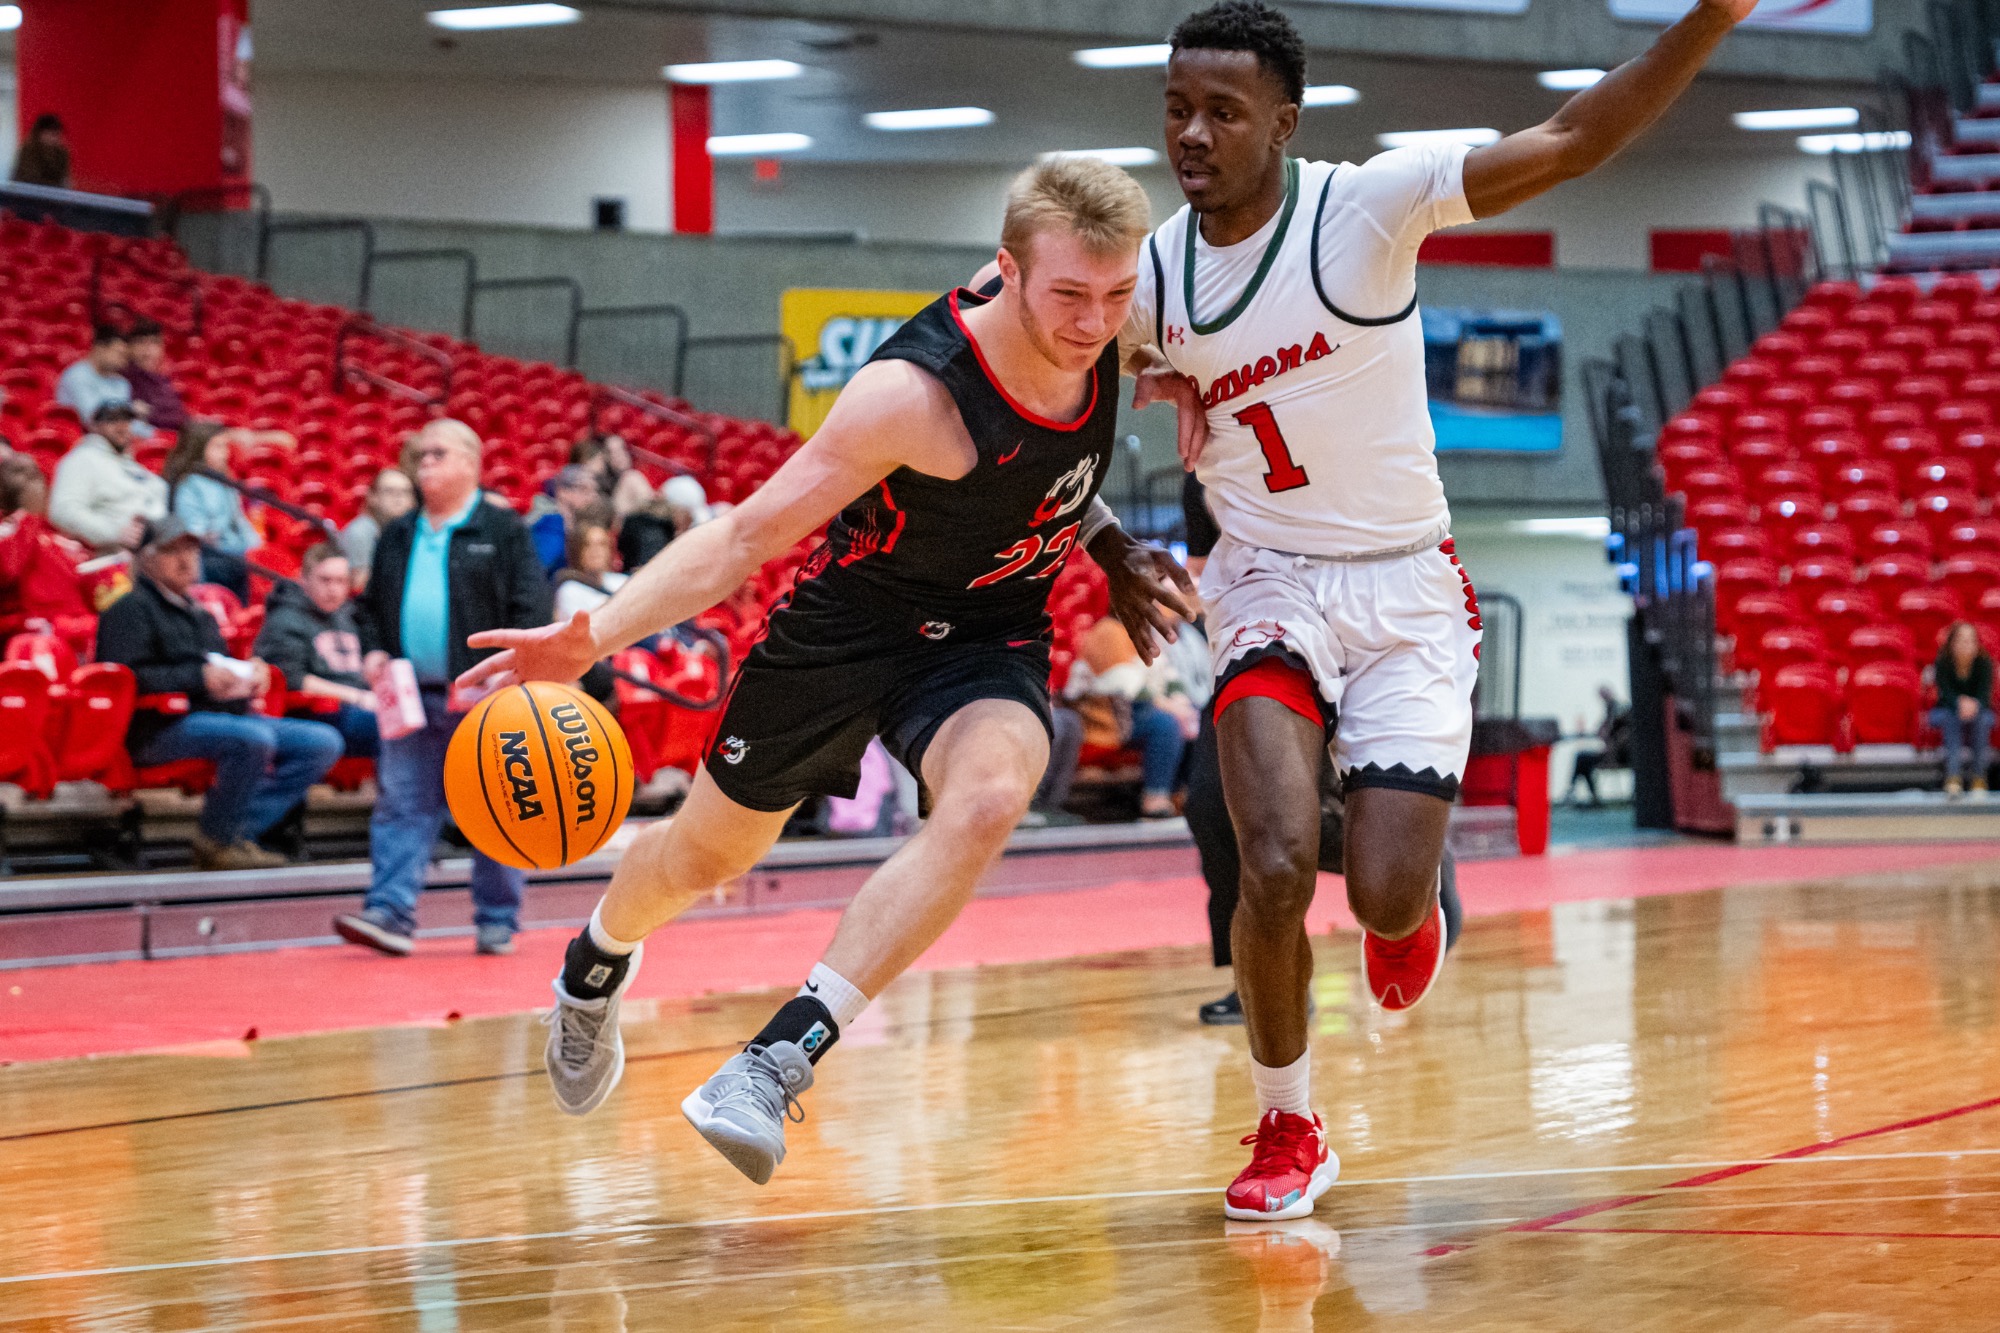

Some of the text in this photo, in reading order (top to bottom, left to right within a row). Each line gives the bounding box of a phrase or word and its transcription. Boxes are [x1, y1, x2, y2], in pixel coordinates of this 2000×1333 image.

[1187, 331, 1341, 410] avers
[1232, 400, 1310, 493] 1
[499, 729, 545, 821] NCAA
[550, 701, 599, 825] Wilson
